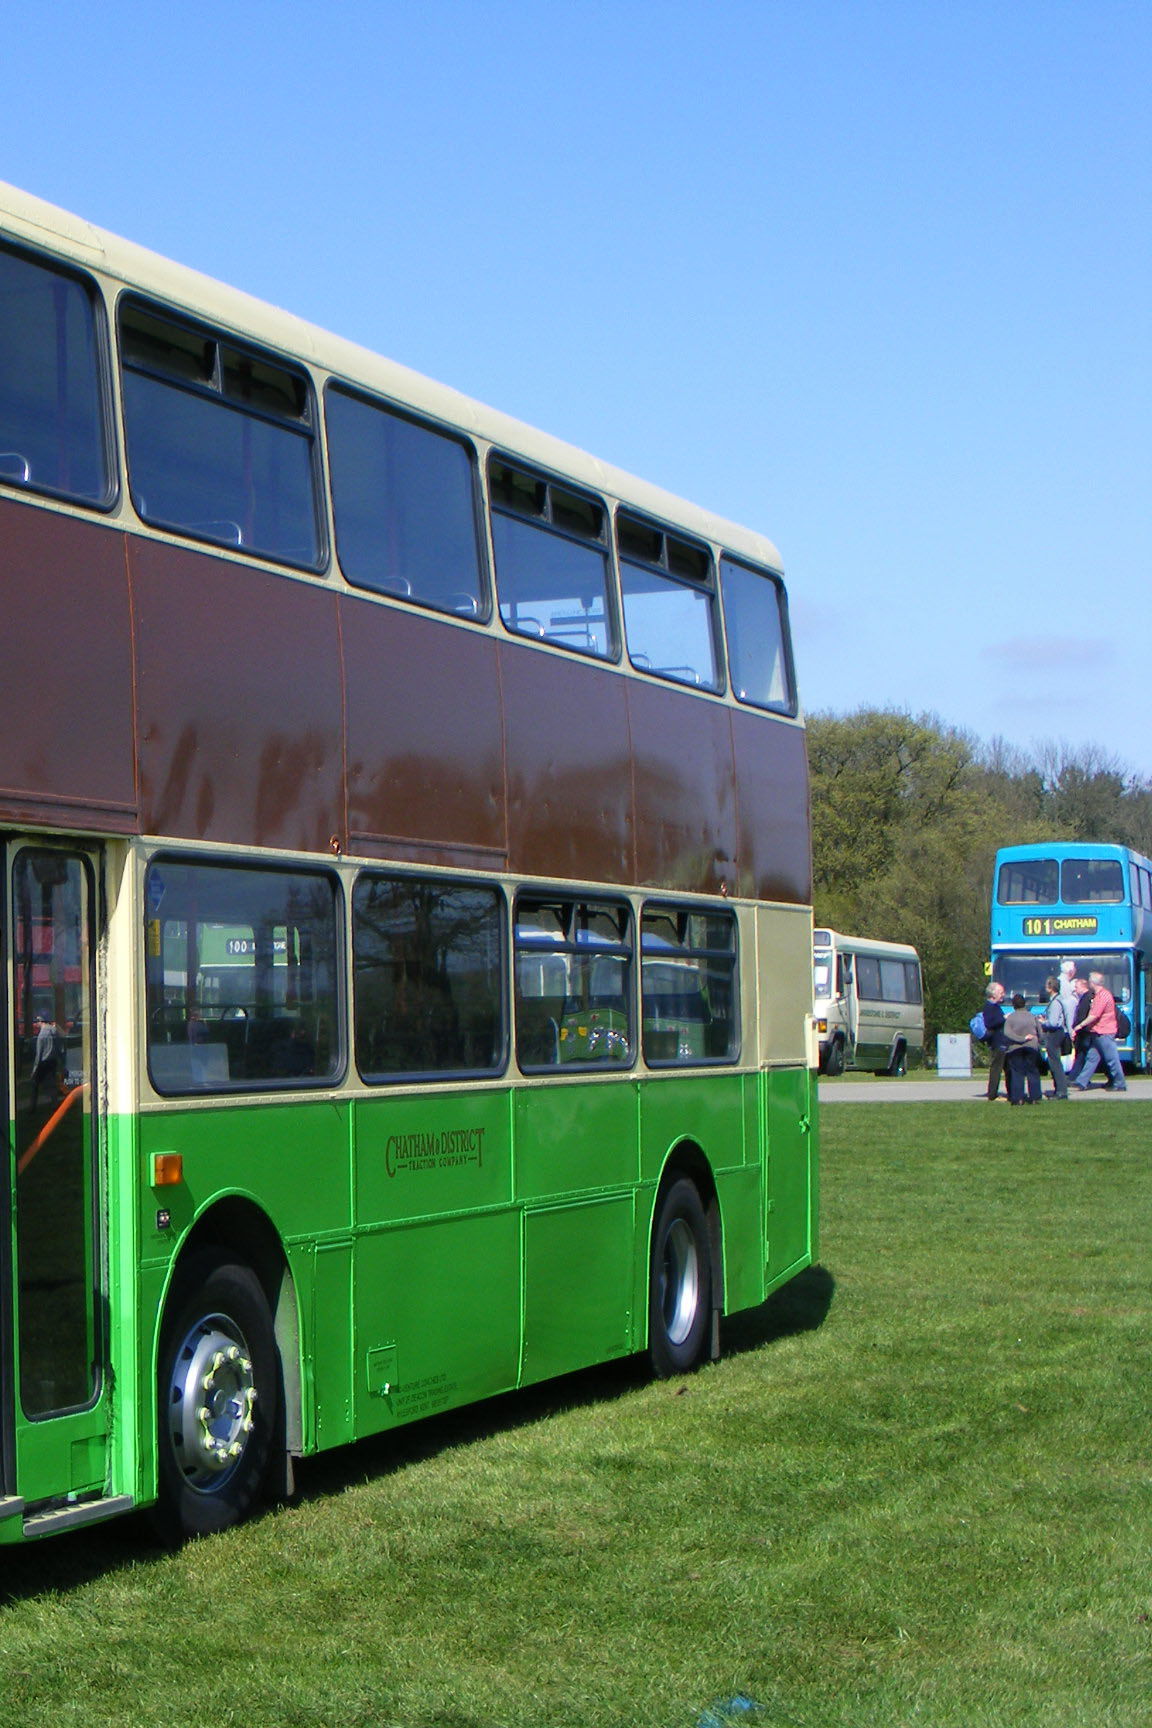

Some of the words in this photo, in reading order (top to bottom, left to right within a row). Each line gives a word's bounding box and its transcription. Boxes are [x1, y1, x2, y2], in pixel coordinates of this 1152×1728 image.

[1027, 919, 1050, 935] 101
[1053, 918, 1097, 930] CHATHAM
[230, 940, 247, 953] 100
[386, 1133, 435, 1177] CHATHAM
[441, 1128, 485, 1167] DISTRICT
[408, 1158, 435, 1171] TRACTION
[439, 1155, 467, 1167] COMPANY
